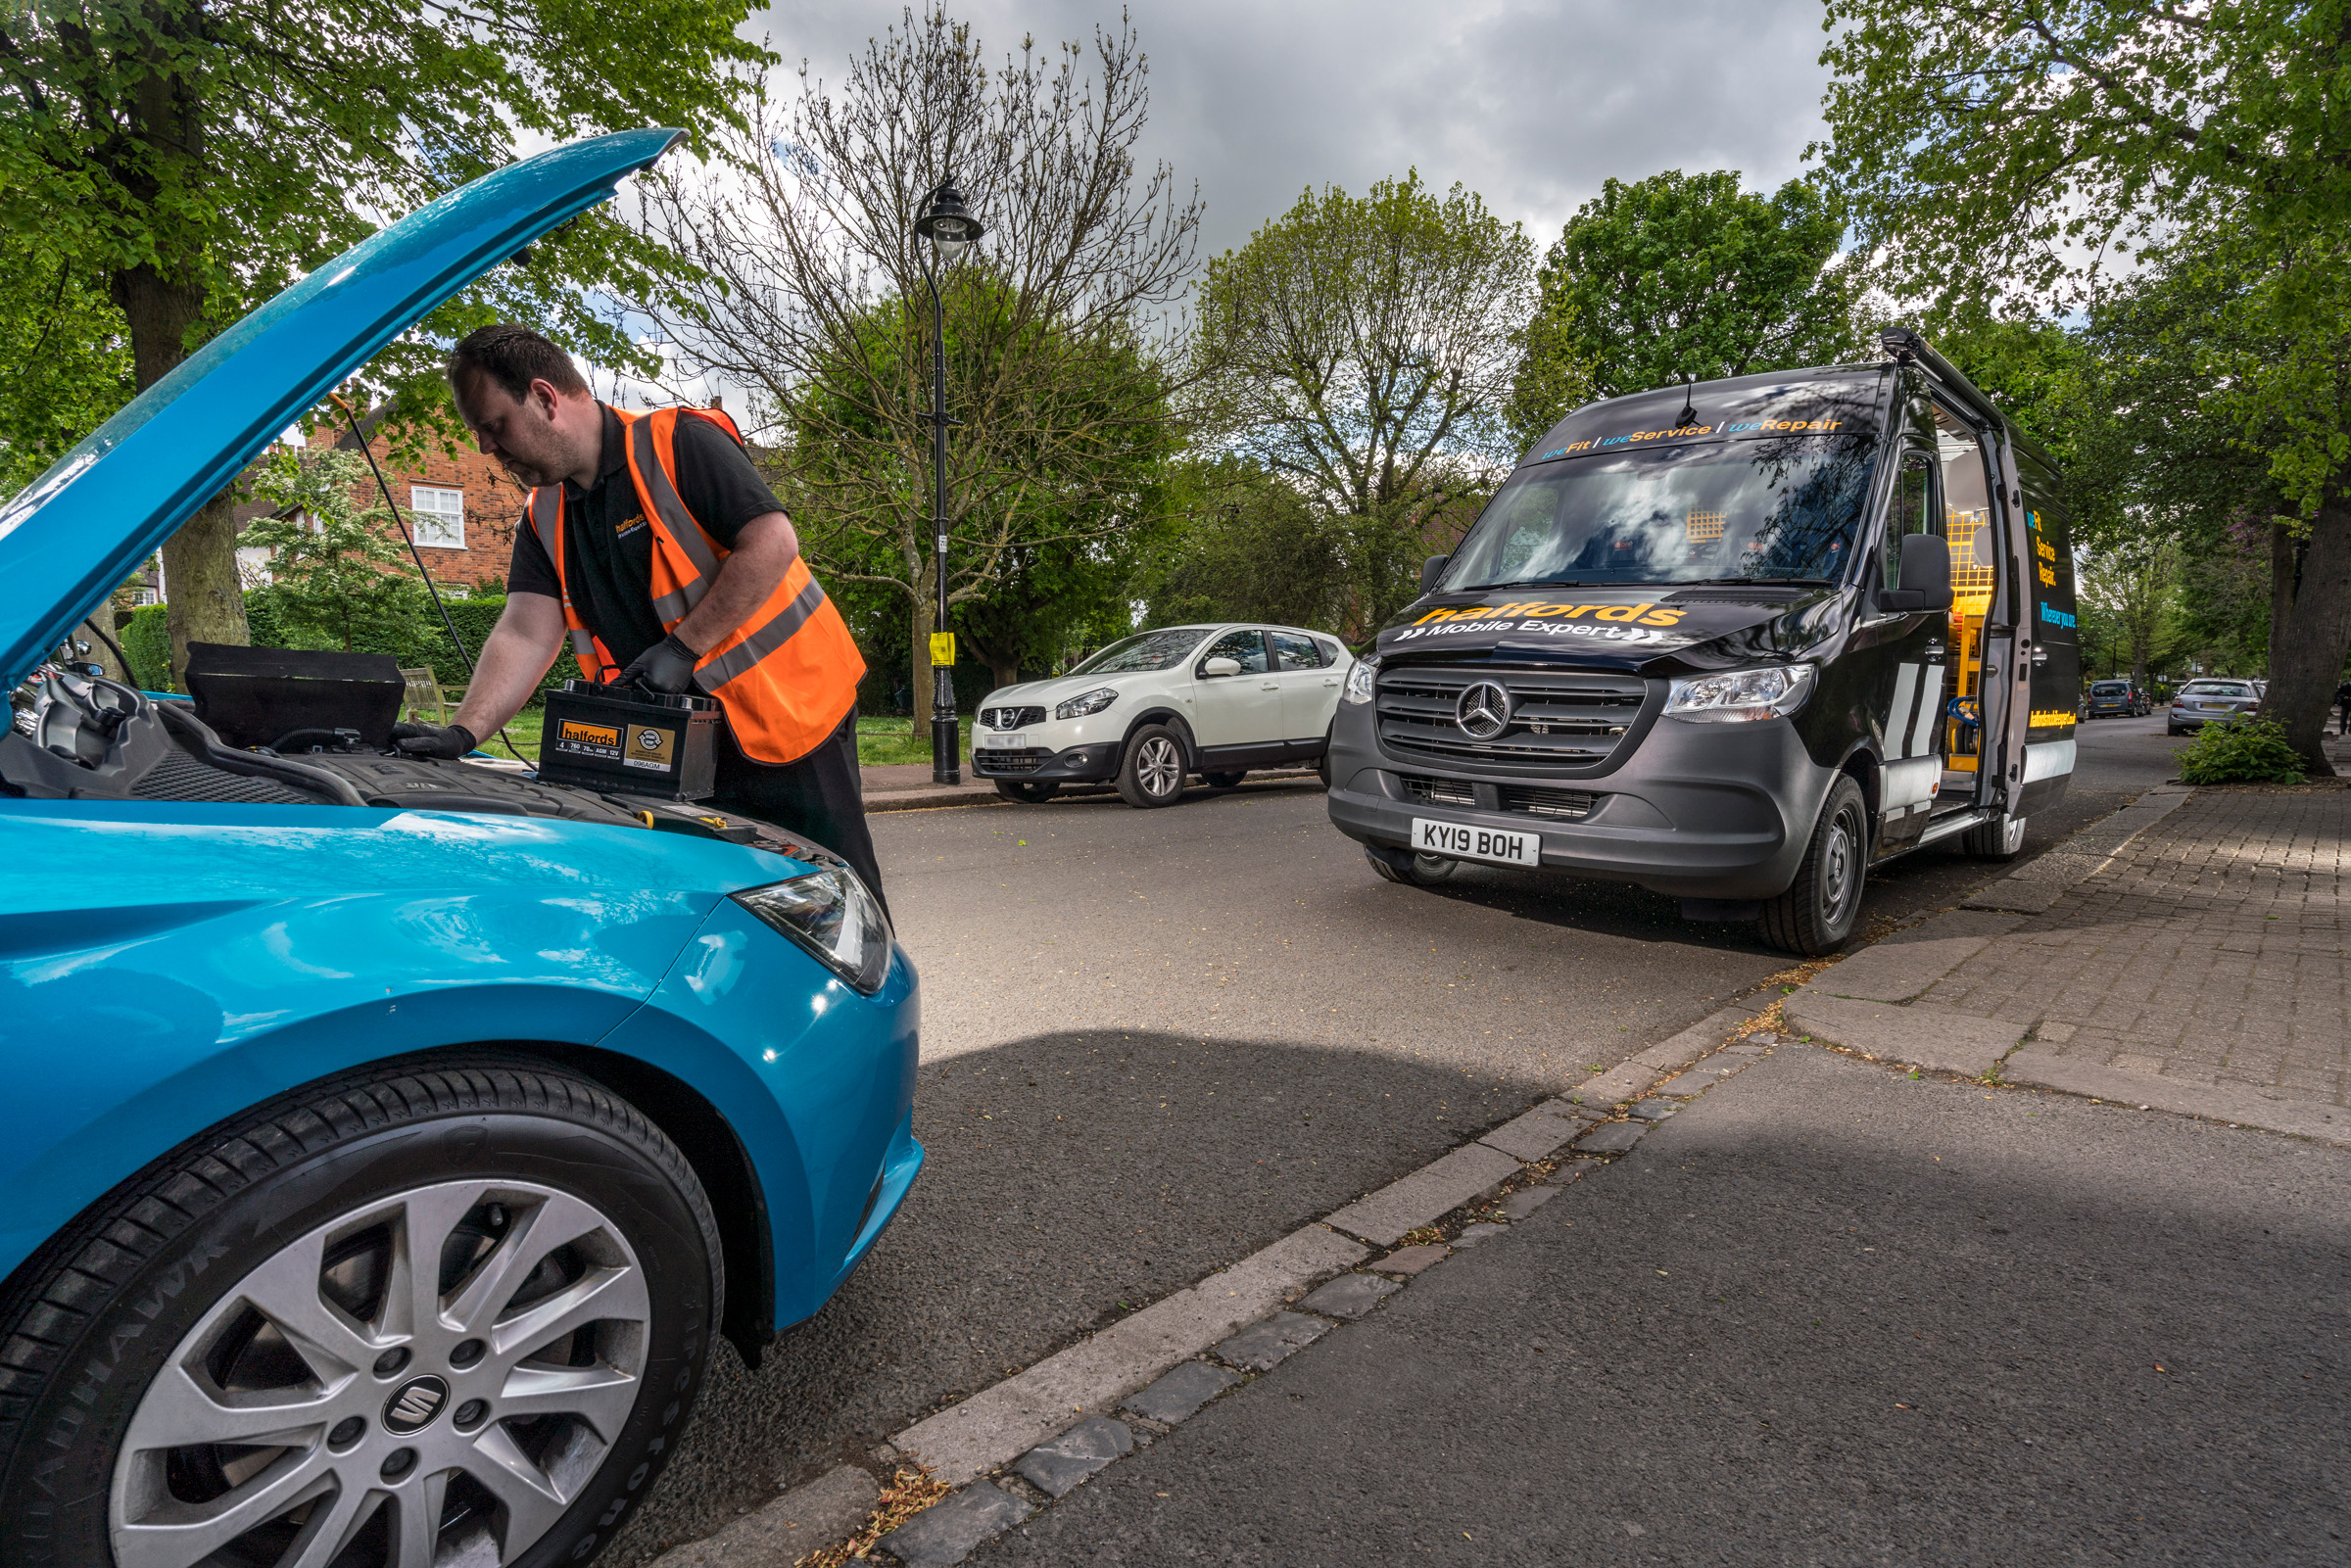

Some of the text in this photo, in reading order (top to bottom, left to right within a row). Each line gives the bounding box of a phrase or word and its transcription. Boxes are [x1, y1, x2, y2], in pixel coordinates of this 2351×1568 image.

[1541, 418, 1842, 459] weFit weService weRepair
[615, 513, 646, 533] halfords
[1411, 601, 1689, 627] halfords
[2040, 601, 2061, 625] Wherever
[2060, 612, 2069, 629] you
[1425, 620, 1621, 639] Mobile Expert
[564, 729, 615, 745] halfords
[1423, 824, 1523, 860] KY19 BOH
